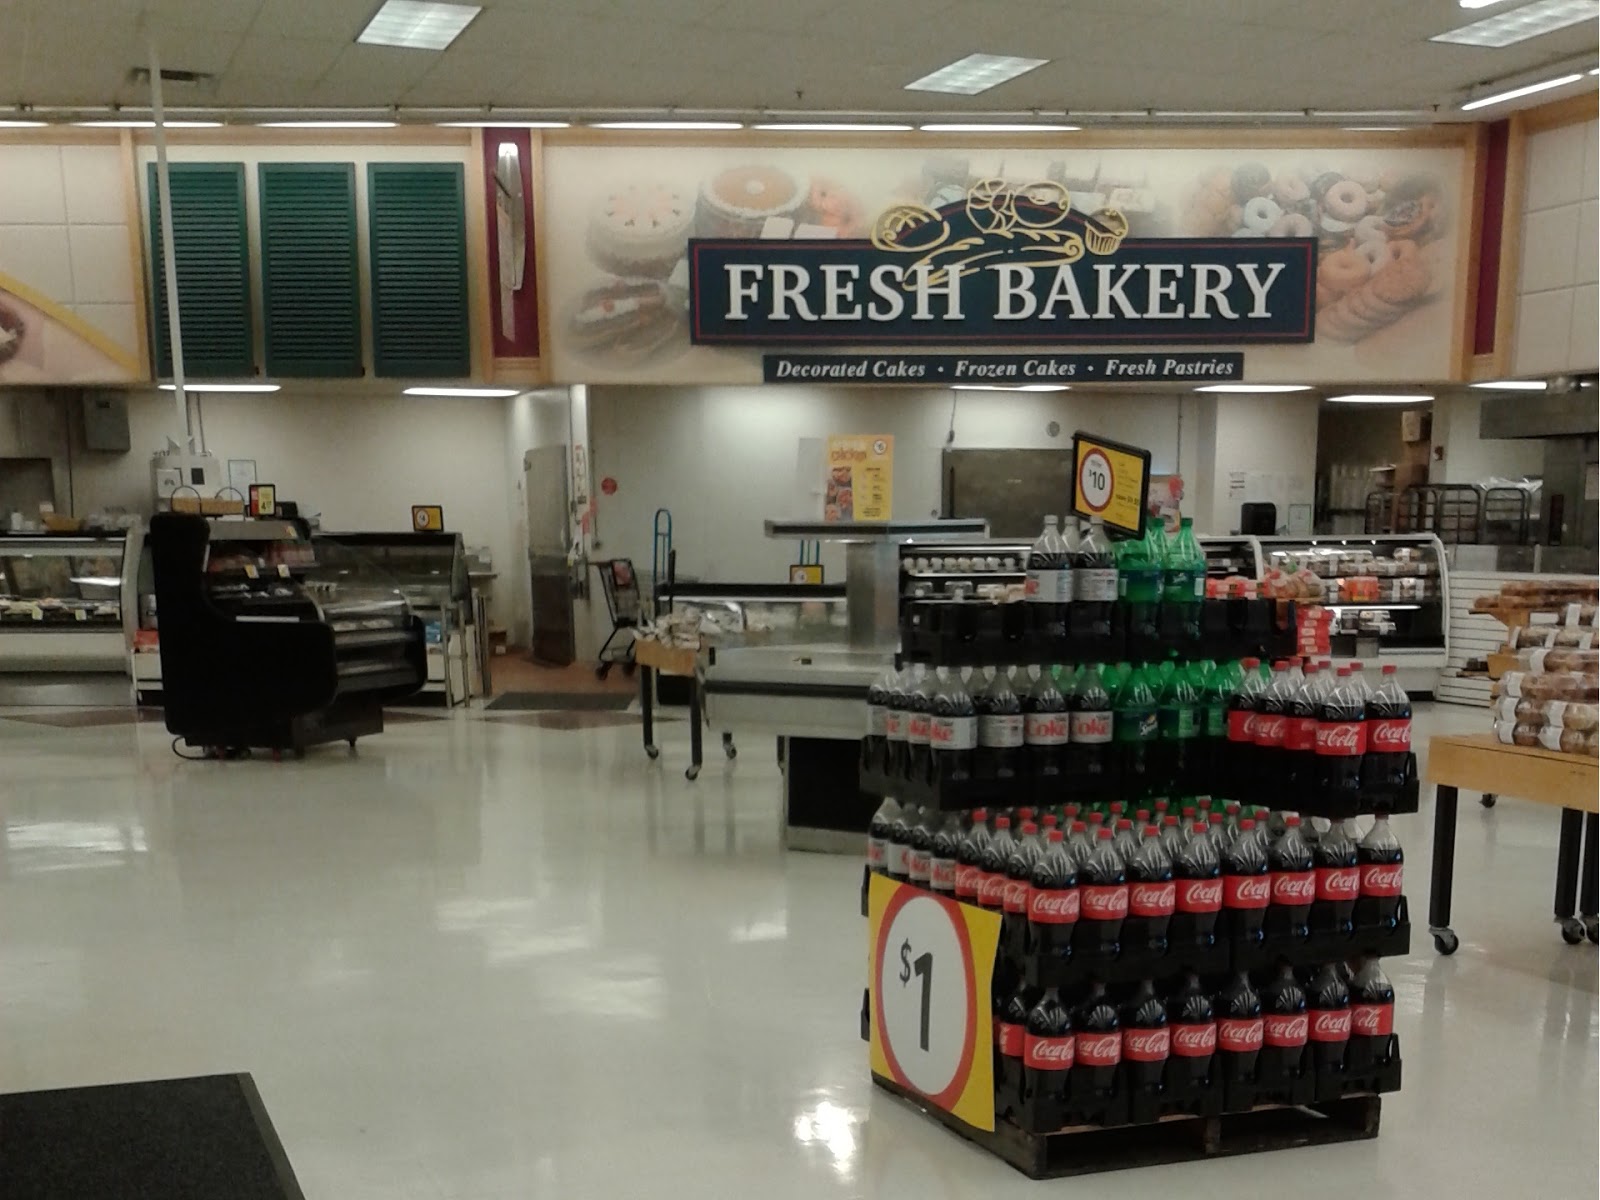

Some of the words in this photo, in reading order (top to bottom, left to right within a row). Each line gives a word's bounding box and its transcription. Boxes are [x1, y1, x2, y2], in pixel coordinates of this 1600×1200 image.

[723, 263, 966, 321] FRESH
[993, 262, 1286, 321] BAKERY
[776, 360, 868, 378] Decorated
[872, 360, 926, 378] Cakes
[955, 360, 1017, 378] Frozen
[1022, 359, 1077, 377] Cakes
[1105, 358, 1157, 376] Fresh
[1162, 358, 1235, 376] Pastries
[900, 937, 934, 1052] $1
